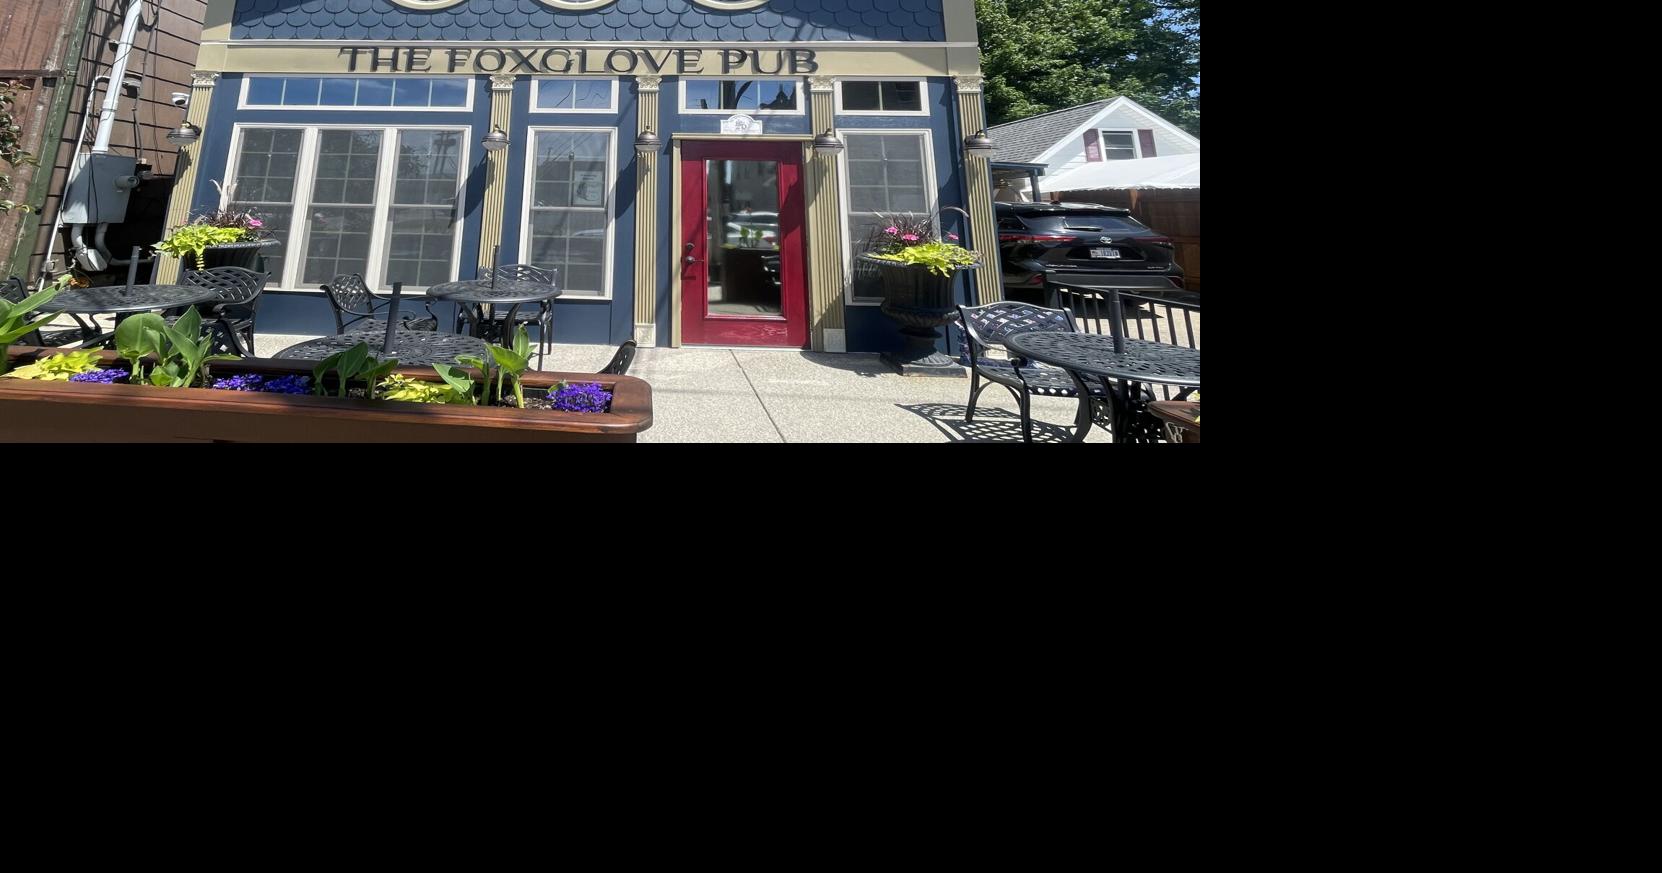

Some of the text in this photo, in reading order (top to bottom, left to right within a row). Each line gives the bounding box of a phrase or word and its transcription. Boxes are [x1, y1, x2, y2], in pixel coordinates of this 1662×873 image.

[338, 47, 818, 74] THE FOXGLOVE PUB
